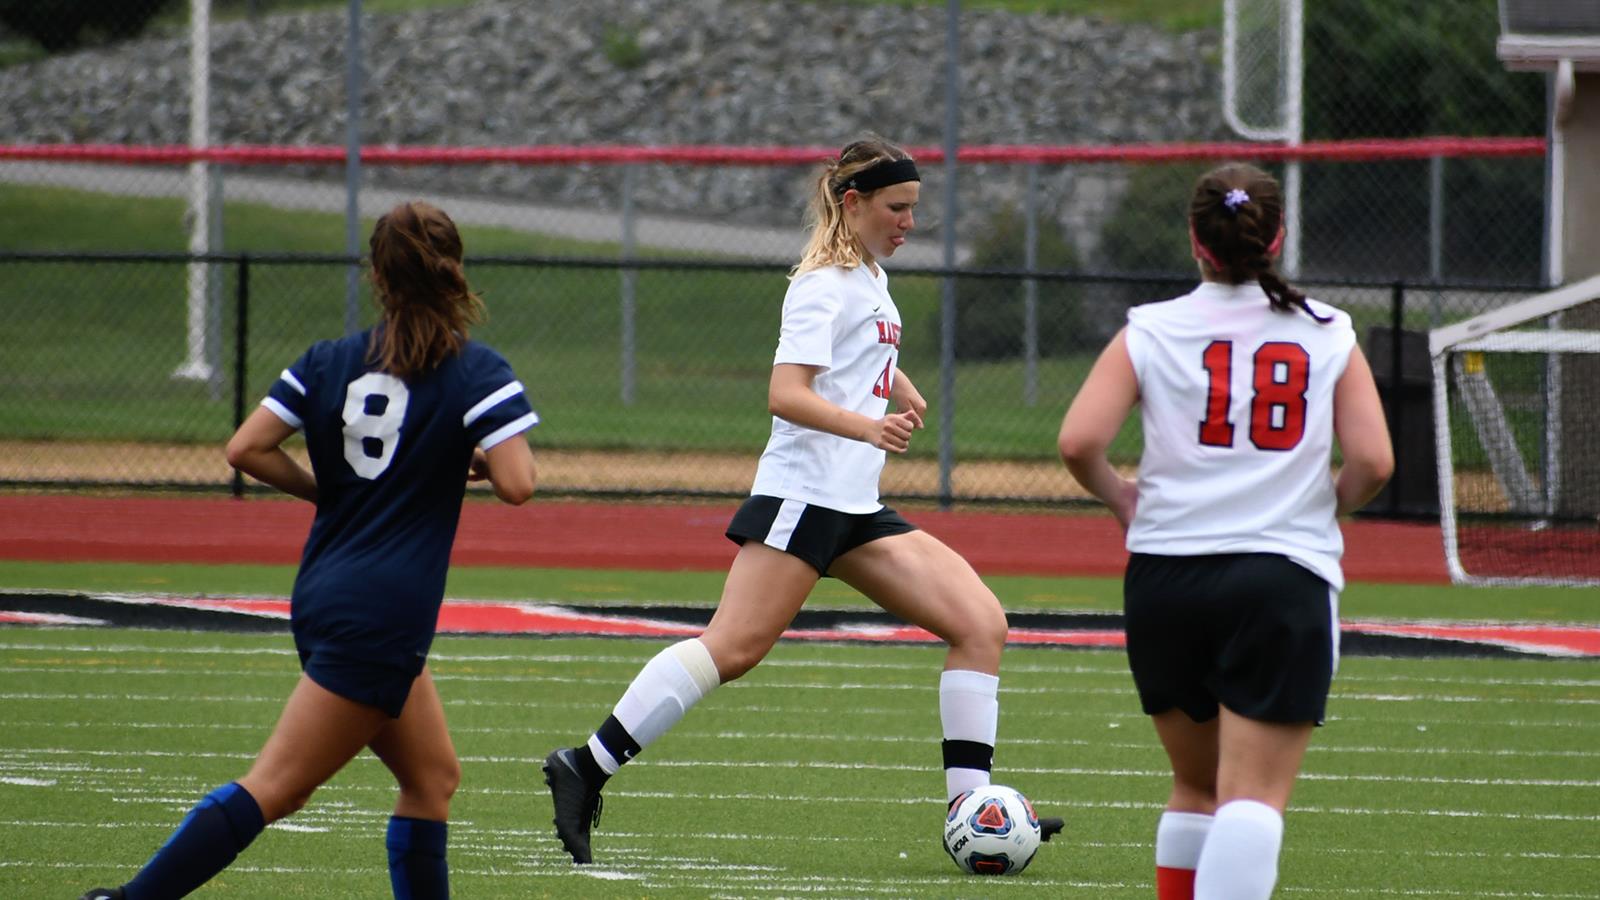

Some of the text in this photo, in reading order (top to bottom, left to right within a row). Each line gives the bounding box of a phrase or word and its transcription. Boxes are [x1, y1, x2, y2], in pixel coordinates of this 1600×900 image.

[342, 371, 410, 480] 8
[1198, 340, 1311, 451] 18
[953, 835, 969, 853] NCAA
